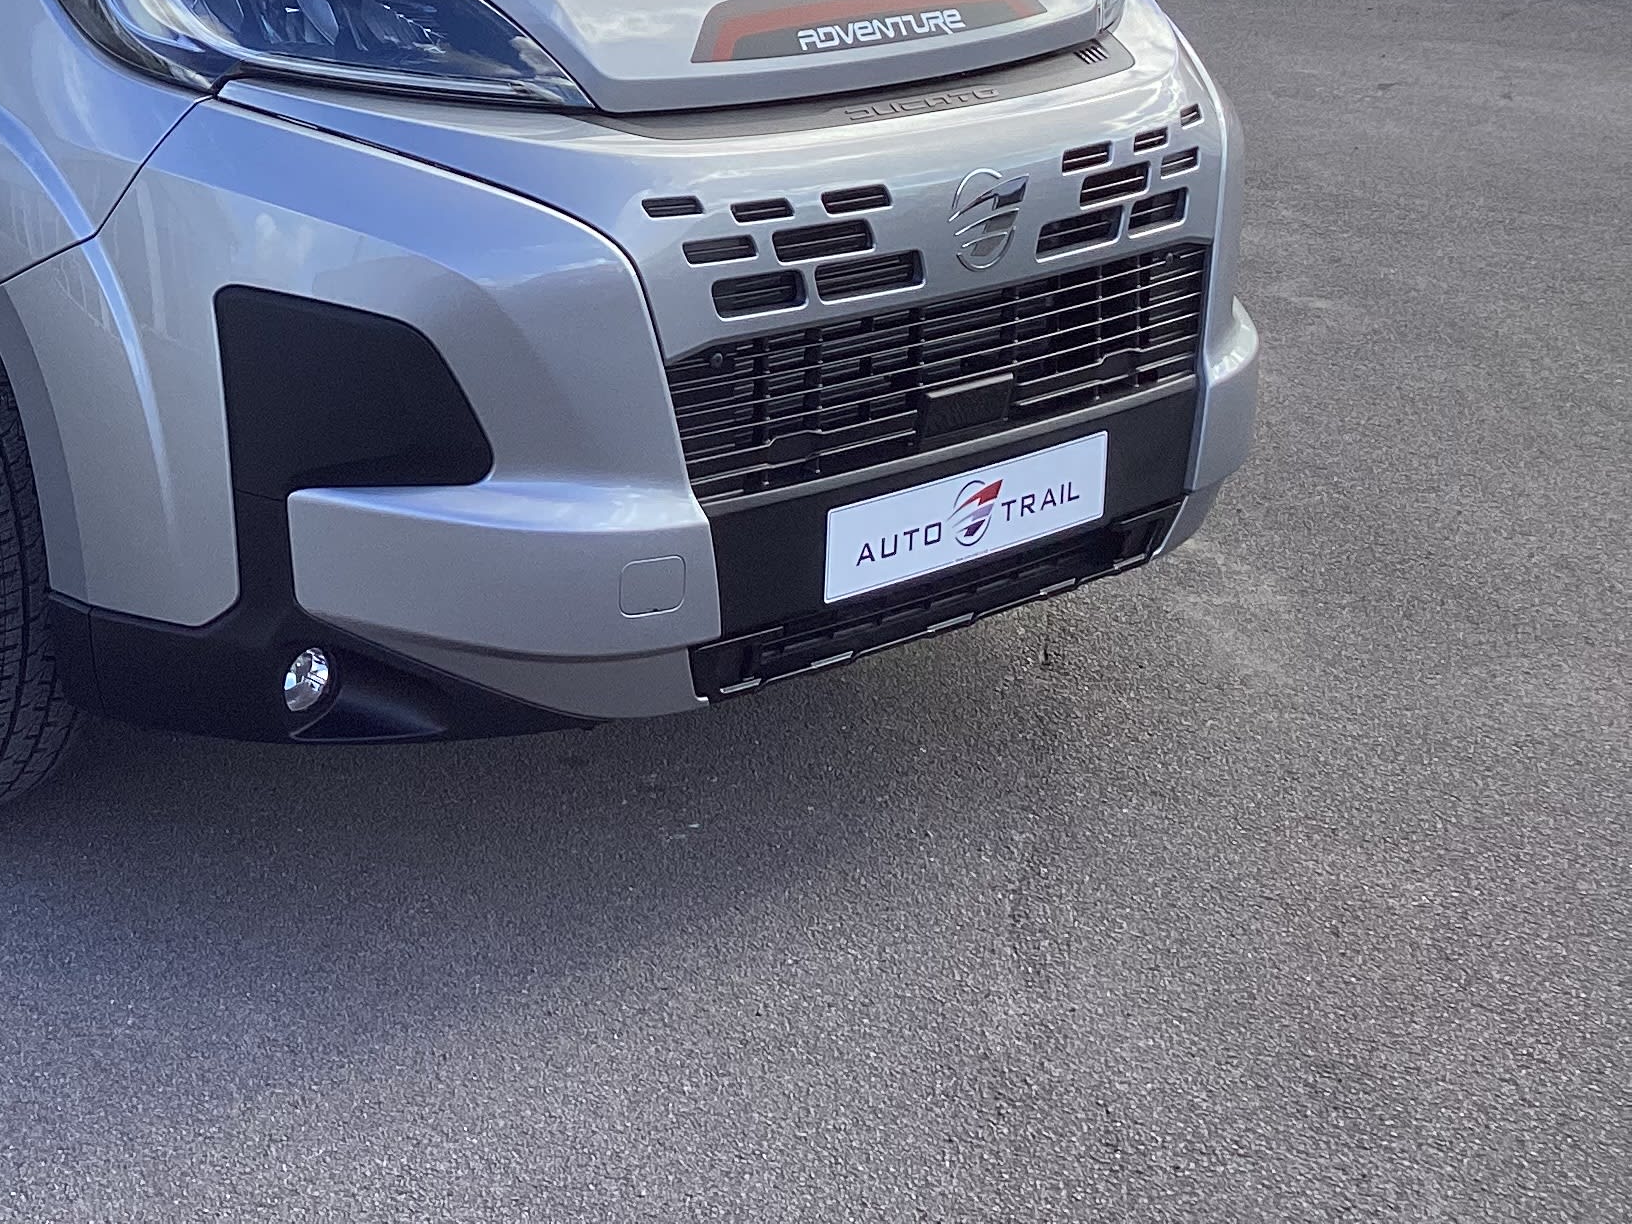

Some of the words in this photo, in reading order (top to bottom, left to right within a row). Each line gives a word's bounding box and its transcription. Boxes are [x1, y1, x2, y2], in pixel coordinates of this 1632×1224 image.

[797, 7, 966, 51] ADVENTURE
[844, 86, 1001, 121] DUCATO
[856, 521, 942, 567] AUTO
[1001, 481, 1080, 522] TRAIL
